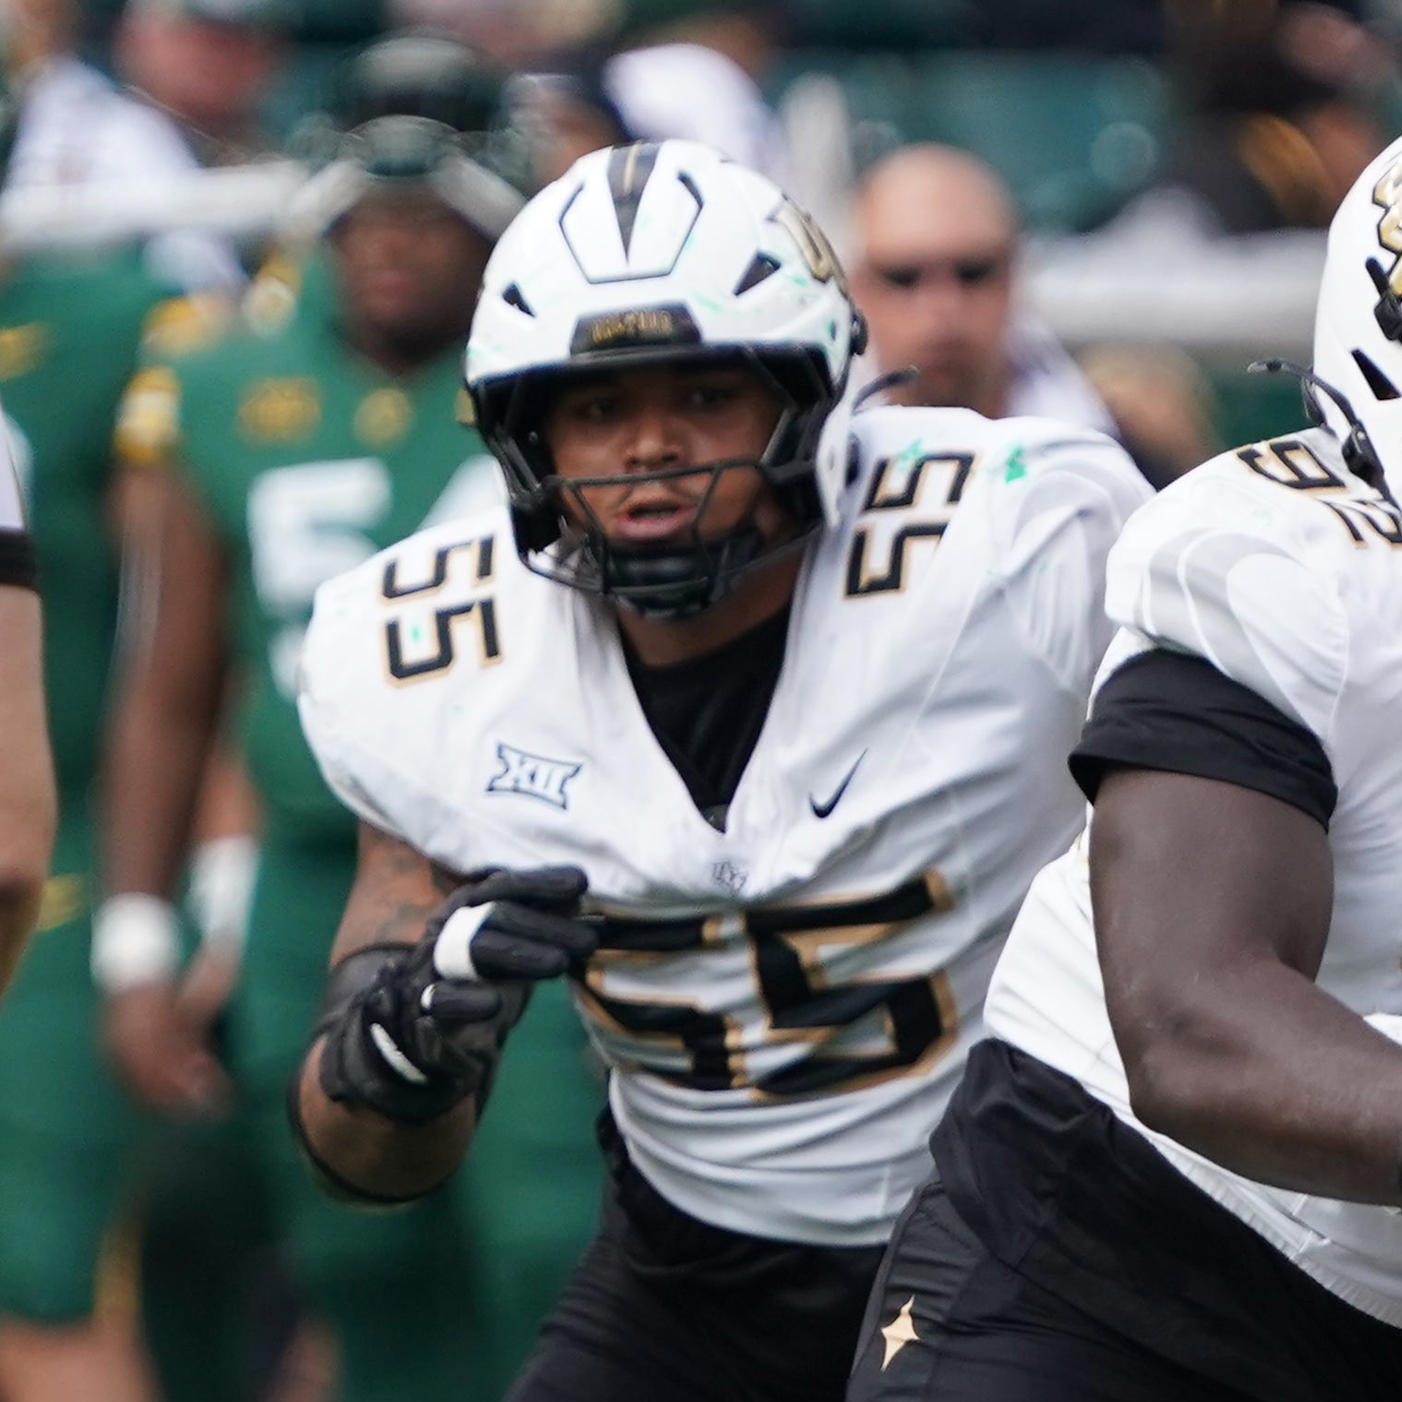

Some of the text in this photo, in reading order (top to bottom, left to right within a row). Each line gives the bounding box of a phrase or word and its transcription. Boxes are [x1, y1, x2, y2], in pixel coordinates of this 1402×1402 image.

[845, 450, 976, 601] 55
[378, 534, 503, 688] 55
[572, 868, 962, 1104] 55
